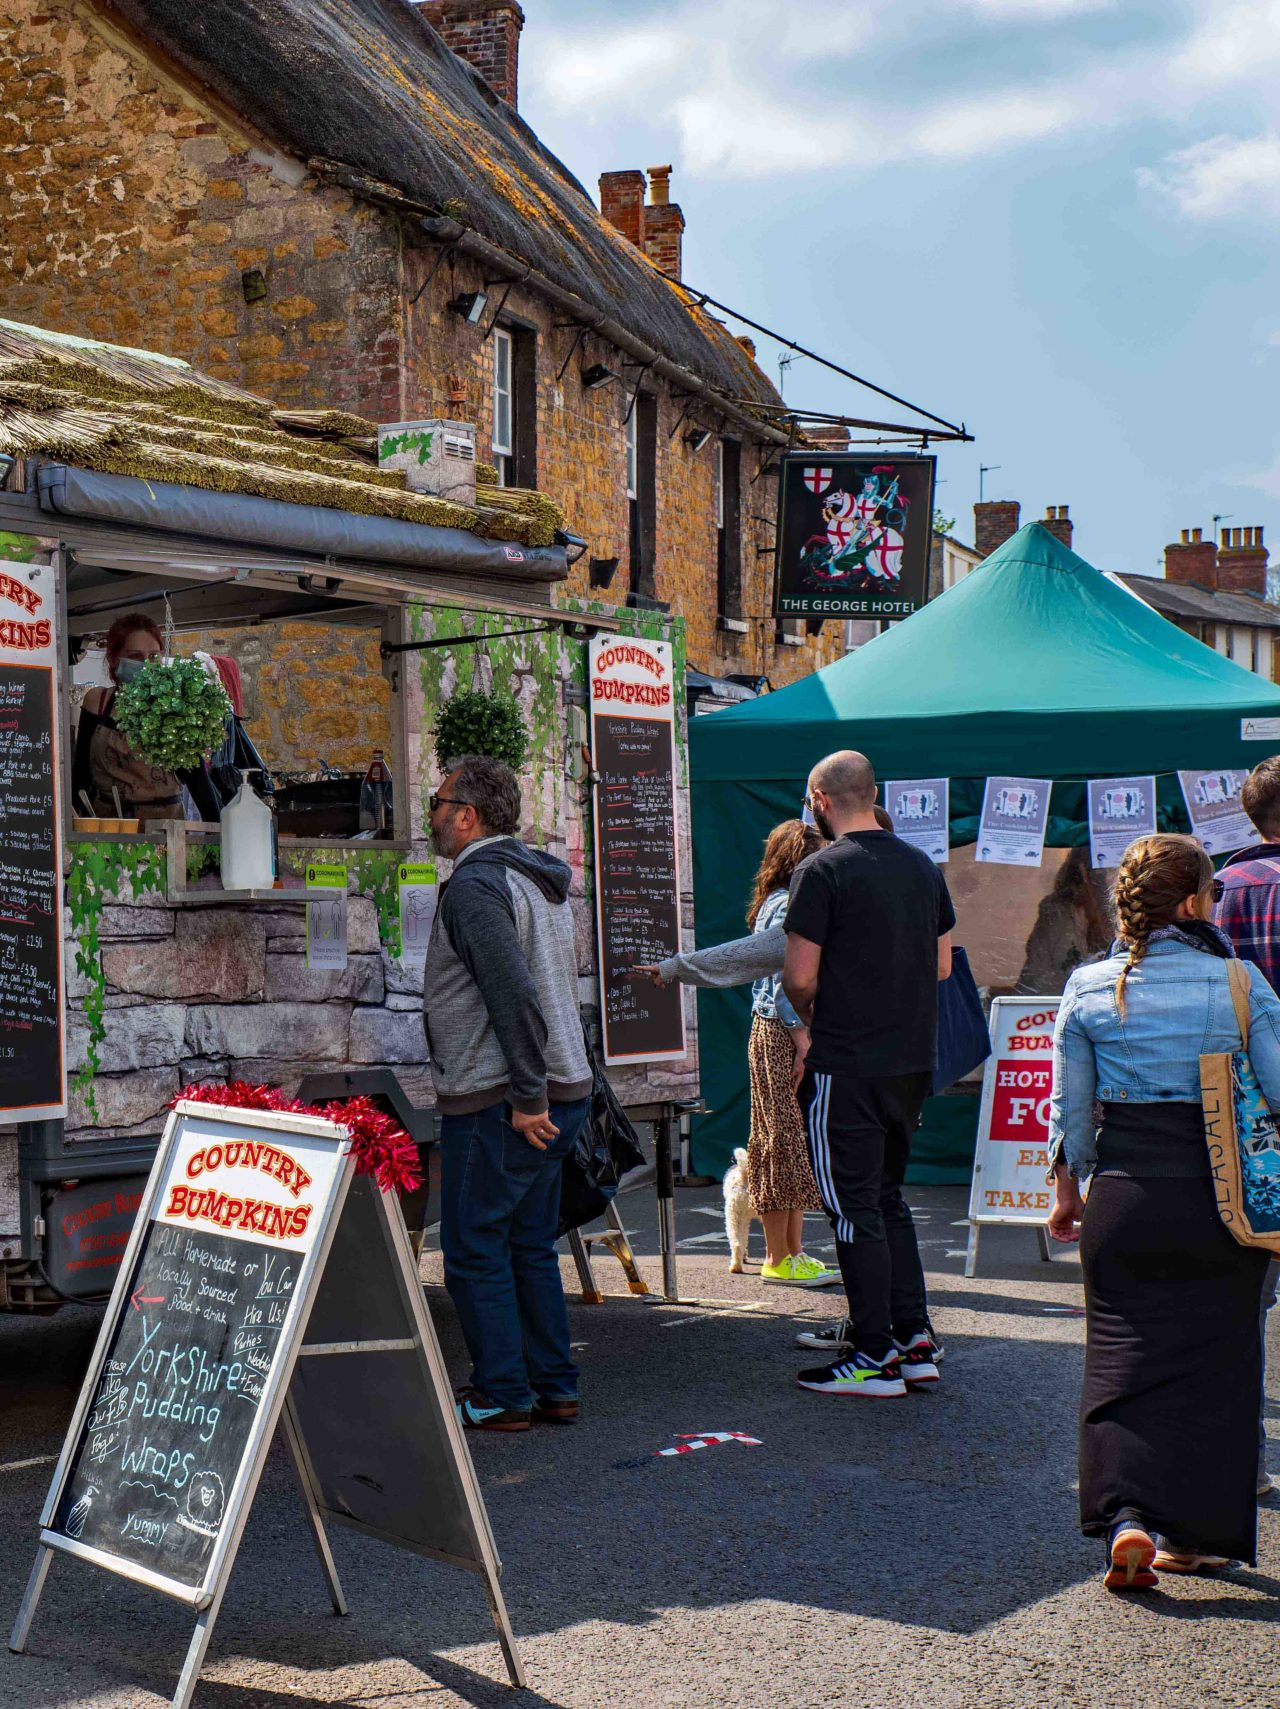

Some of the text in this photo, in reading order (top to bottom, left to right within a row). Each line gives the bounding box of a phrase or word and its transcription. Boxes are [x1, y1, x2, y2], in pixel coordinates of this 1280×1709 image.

[782, 599, 917, 613] THE GEORGE HOTEL
[596, 645, 665, 680] COUNTRY
[592, 677, 671, 707] BUMPKINS
[41, 732, 50, 744] £6
[42, 762, 51, 774] £6
[43, 796, 52, 807] £5
[26, 935, 43, 949] £2.50
[998, 1071, 1049, 1088] HOT
[186, 1139, 312, 1199] COUNTRY
[165, 1184, 313, 1240] BUMPKINS
[985, 1190, 1050, 1209] TAKE
[157, 1228, 178, 1257] All
[243, 1263, 259, 1277] or
[198, 1277, 238, 1305] Sourced
[128, 1382, 221, 1442] Pudding
[121, 1436, 195, 1488] Wraps
